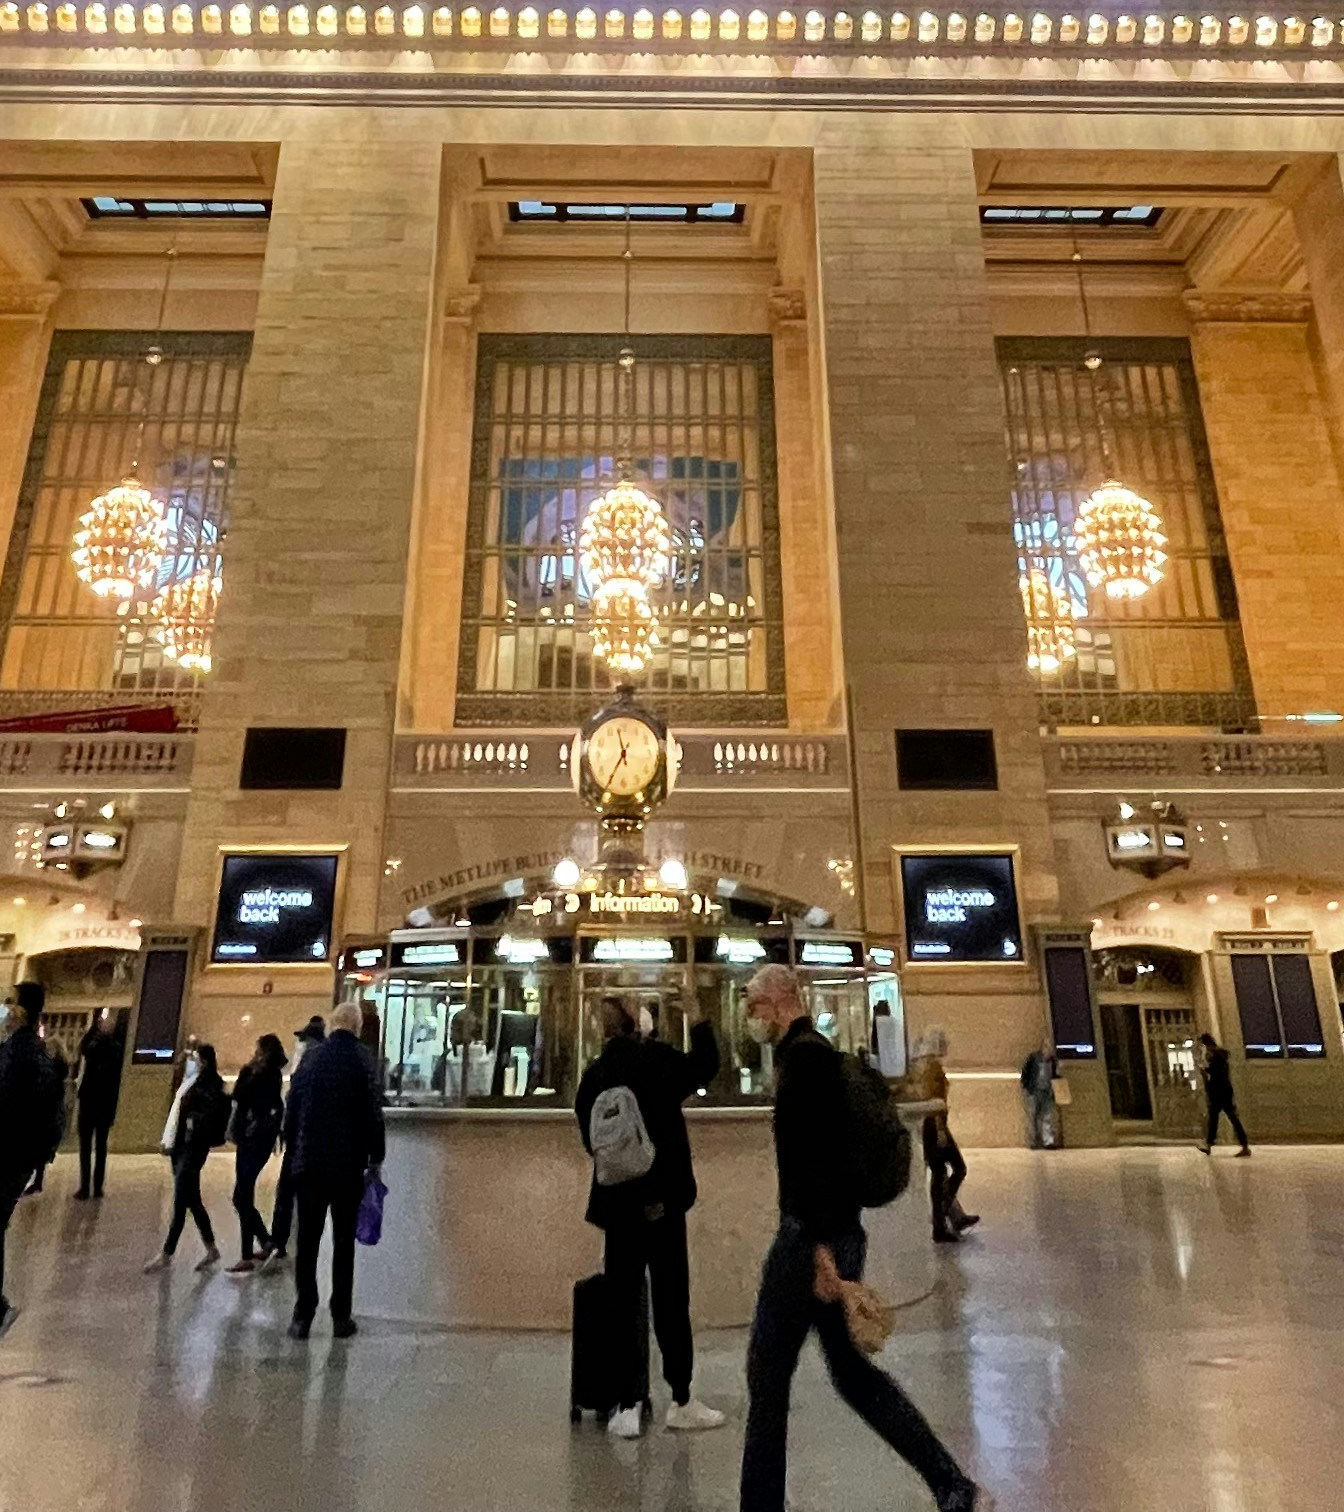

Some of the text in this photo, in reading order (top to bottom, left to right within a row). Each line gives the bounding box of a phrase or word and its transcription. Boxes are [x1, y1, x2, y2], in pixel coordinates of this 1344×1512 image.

[402, 879, 437, 904] THE
[439, 857, 510, 889] METLIFE
[701, 853, 763, 879] STREET
[242, 888, 313, 906] welcome
[926, 888, 995, 906] welcome
[239, 905, 280, 922] back
[926, 905, 967, 922] back
